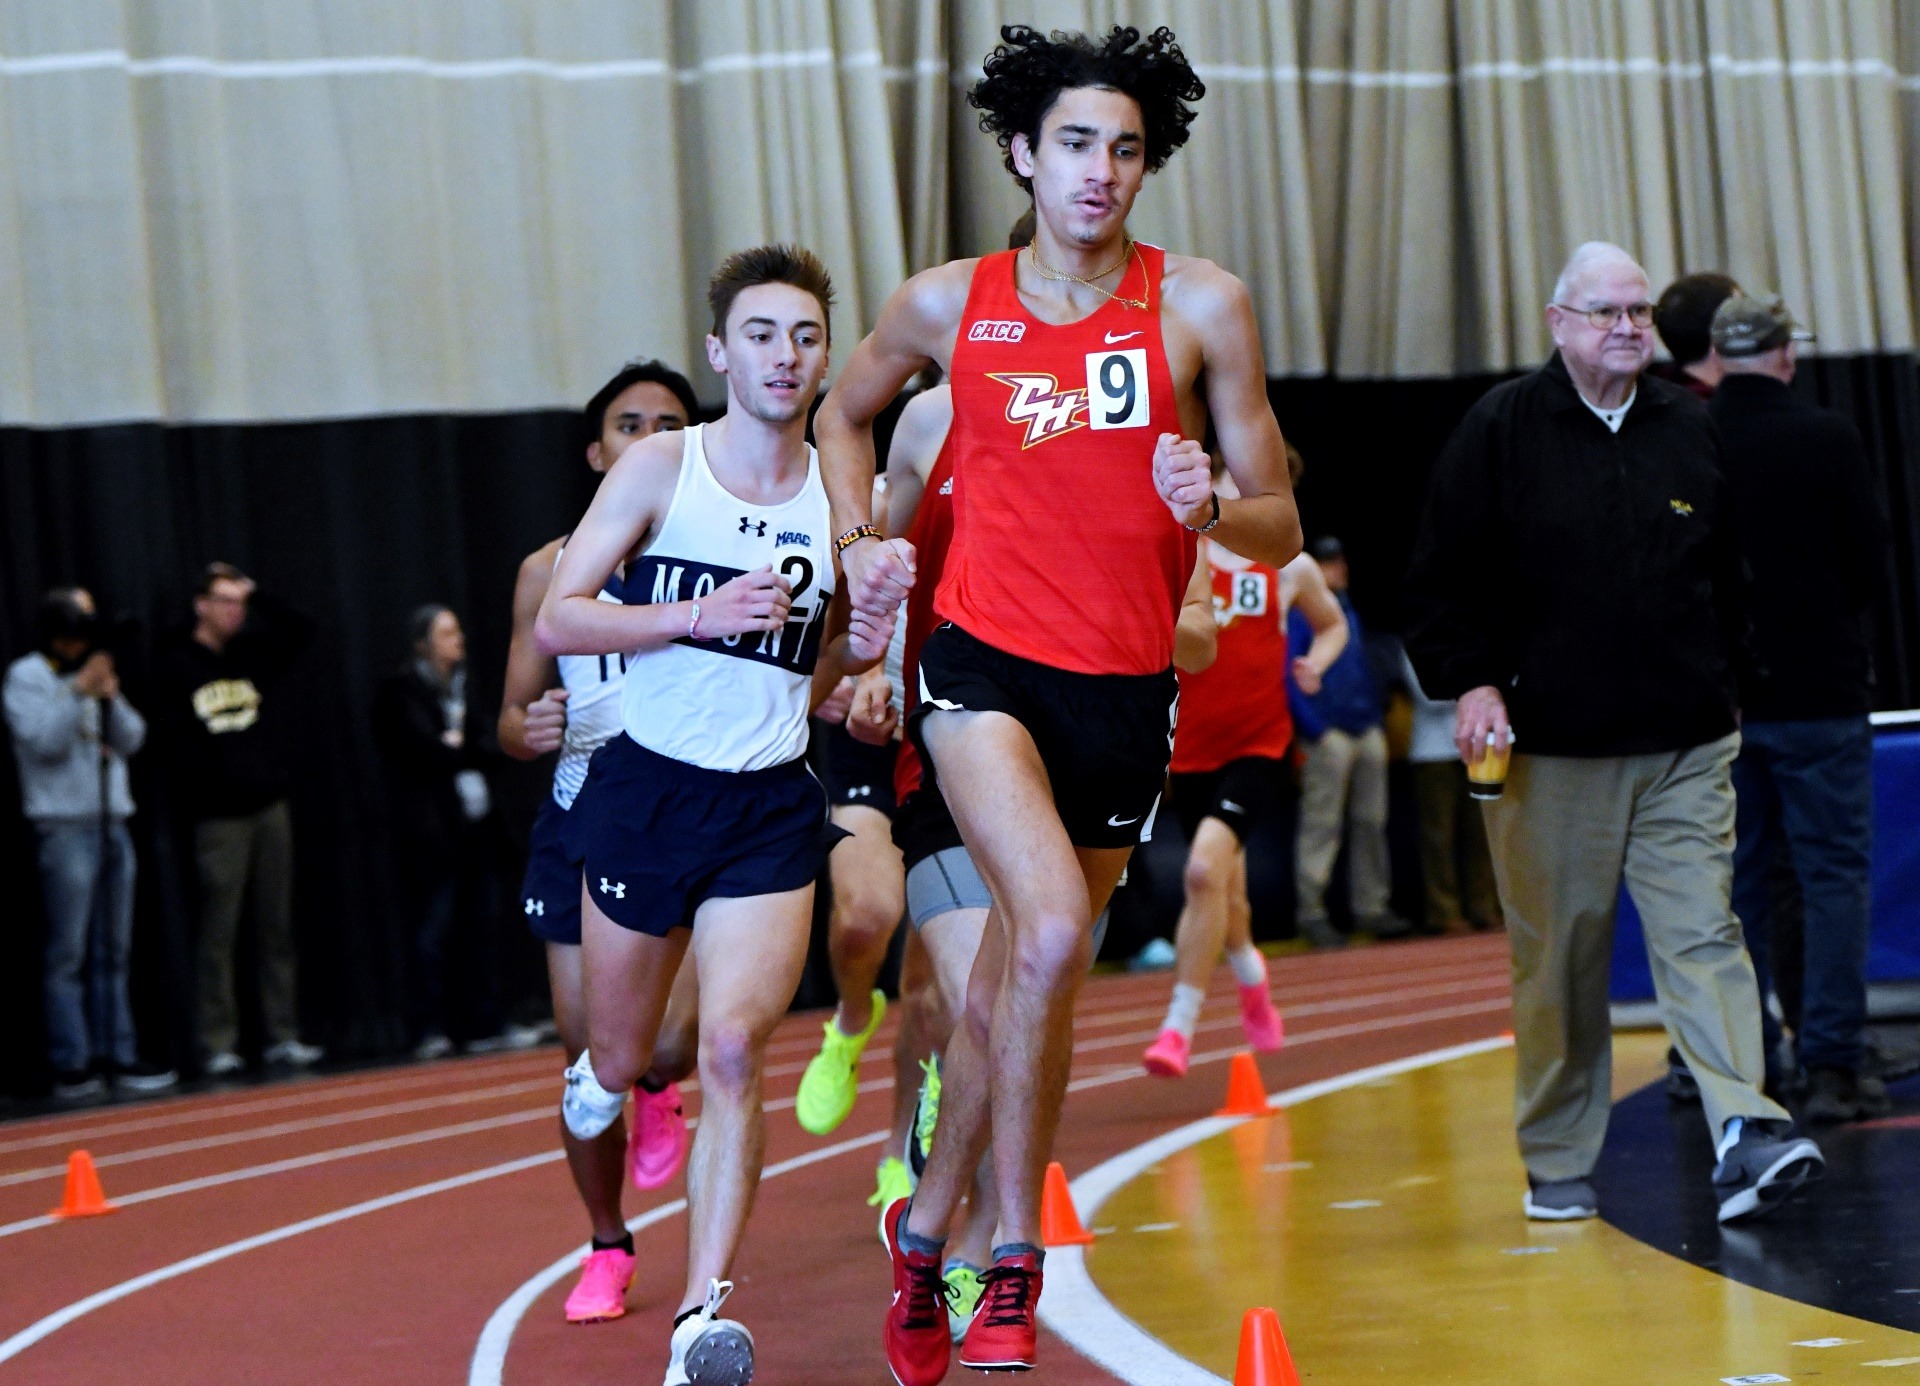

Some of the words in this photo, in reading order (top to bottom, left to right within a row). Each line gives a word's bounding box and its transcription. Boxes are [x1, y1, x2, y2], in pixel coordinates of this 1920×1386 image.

[970, 322, 1024, 341] CACC
[1100, 354, 1136, 424] 9
[775, 531, 811, 548] MAAC
[781, 556, 813, 617] 2
[1240, 579, 1259, 609] 8
